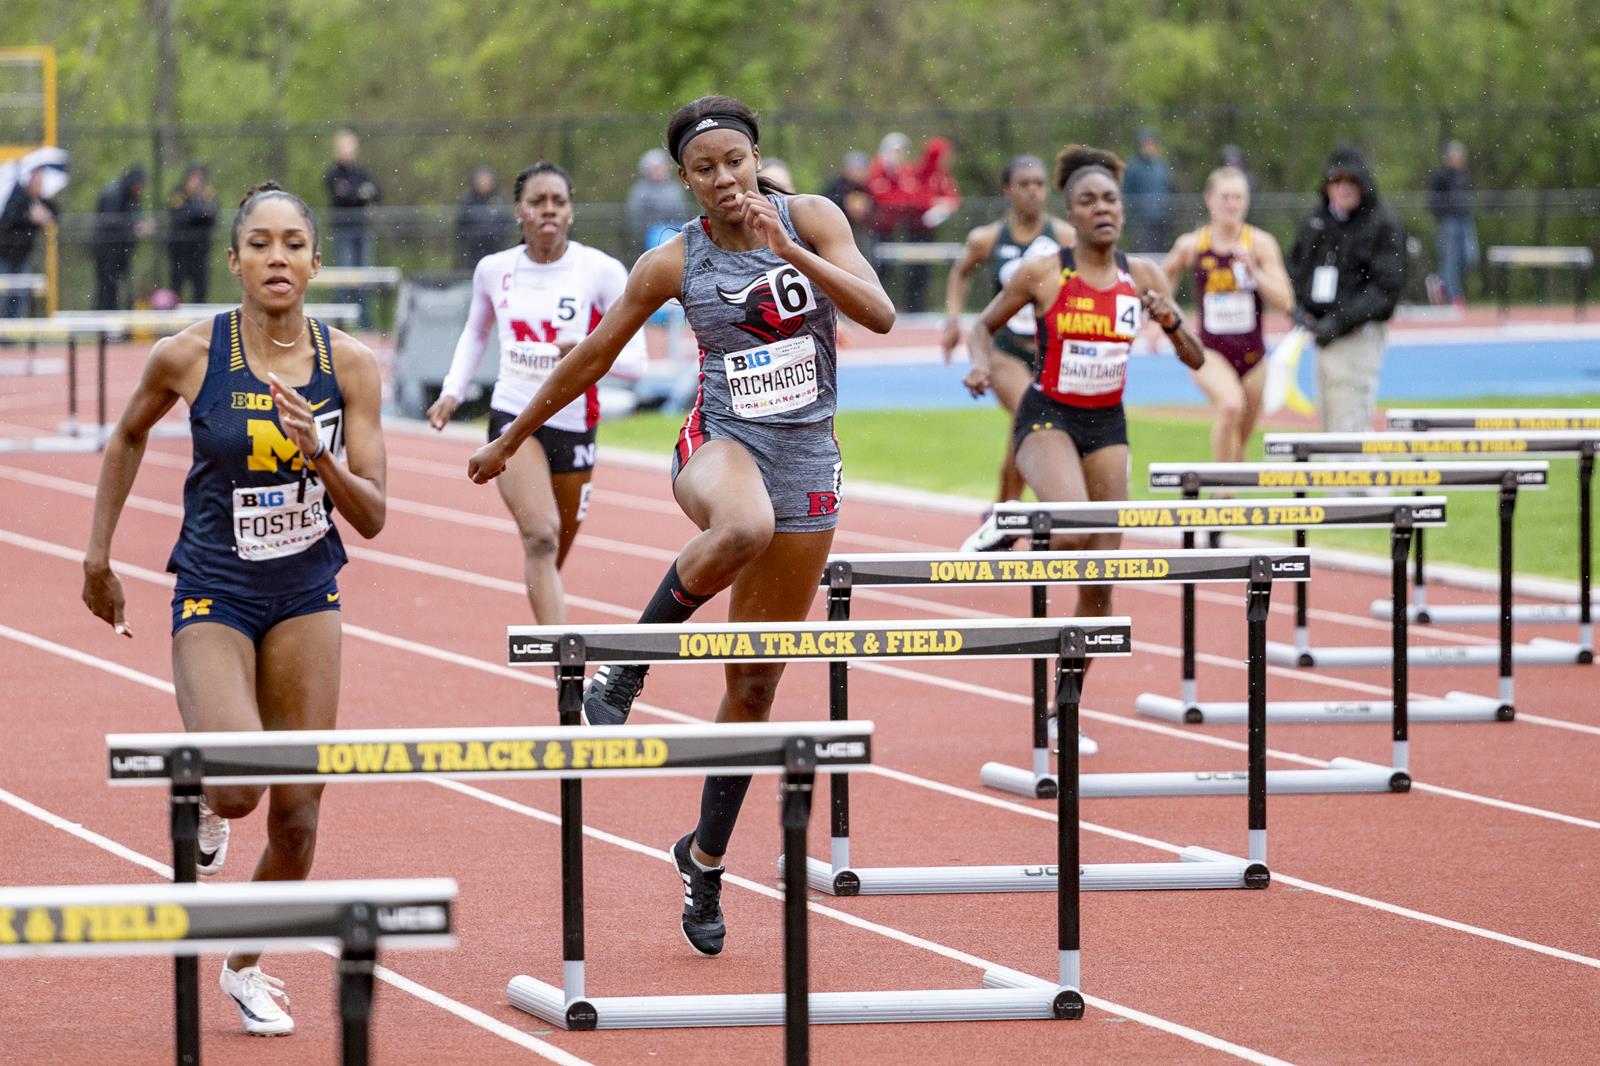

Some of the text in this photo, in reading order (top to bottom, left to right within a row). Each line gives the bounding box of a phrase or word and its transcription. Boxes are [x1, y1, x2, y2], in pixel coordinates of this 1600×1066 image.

[775, 268, 808, 313] 6
[558, 297, 577, 321] 5
[1121, 305, 1136, 330] 4
[730, 360, 815, 397] RICHARDS
[321, 416, 340, 454] 7
[573, 443, 595, 468] N
[1258, 470, 1308, 486] IOWA
[1311, 470, 1372, 485] TRACK
[1391, 470, 1442, 484] FIELD
[807, 492, 838, 517] R
[1118, 507, 1326, 526] IOWA TRACK & FIELD
[239, 501, 323, 538] FOSTER
[930, 559, 1169, 581] IOWA TRACK & FIELD
[1272, 562, 1305, 572] UCS
[182, 598, 214, 619] M
[513, 644, 554, 654] UCS
[679, 630, 963, 656] IOWA TRACK & FIELD
[1085, 634, 1124, 645] UCS
[317, 738, 668, 773] IOWA TRACK & FIELD
[815, 742, 865, 757] UCS
[113, 755, 165, 771] UCS
[62, 902, 190, 941] FIELD
